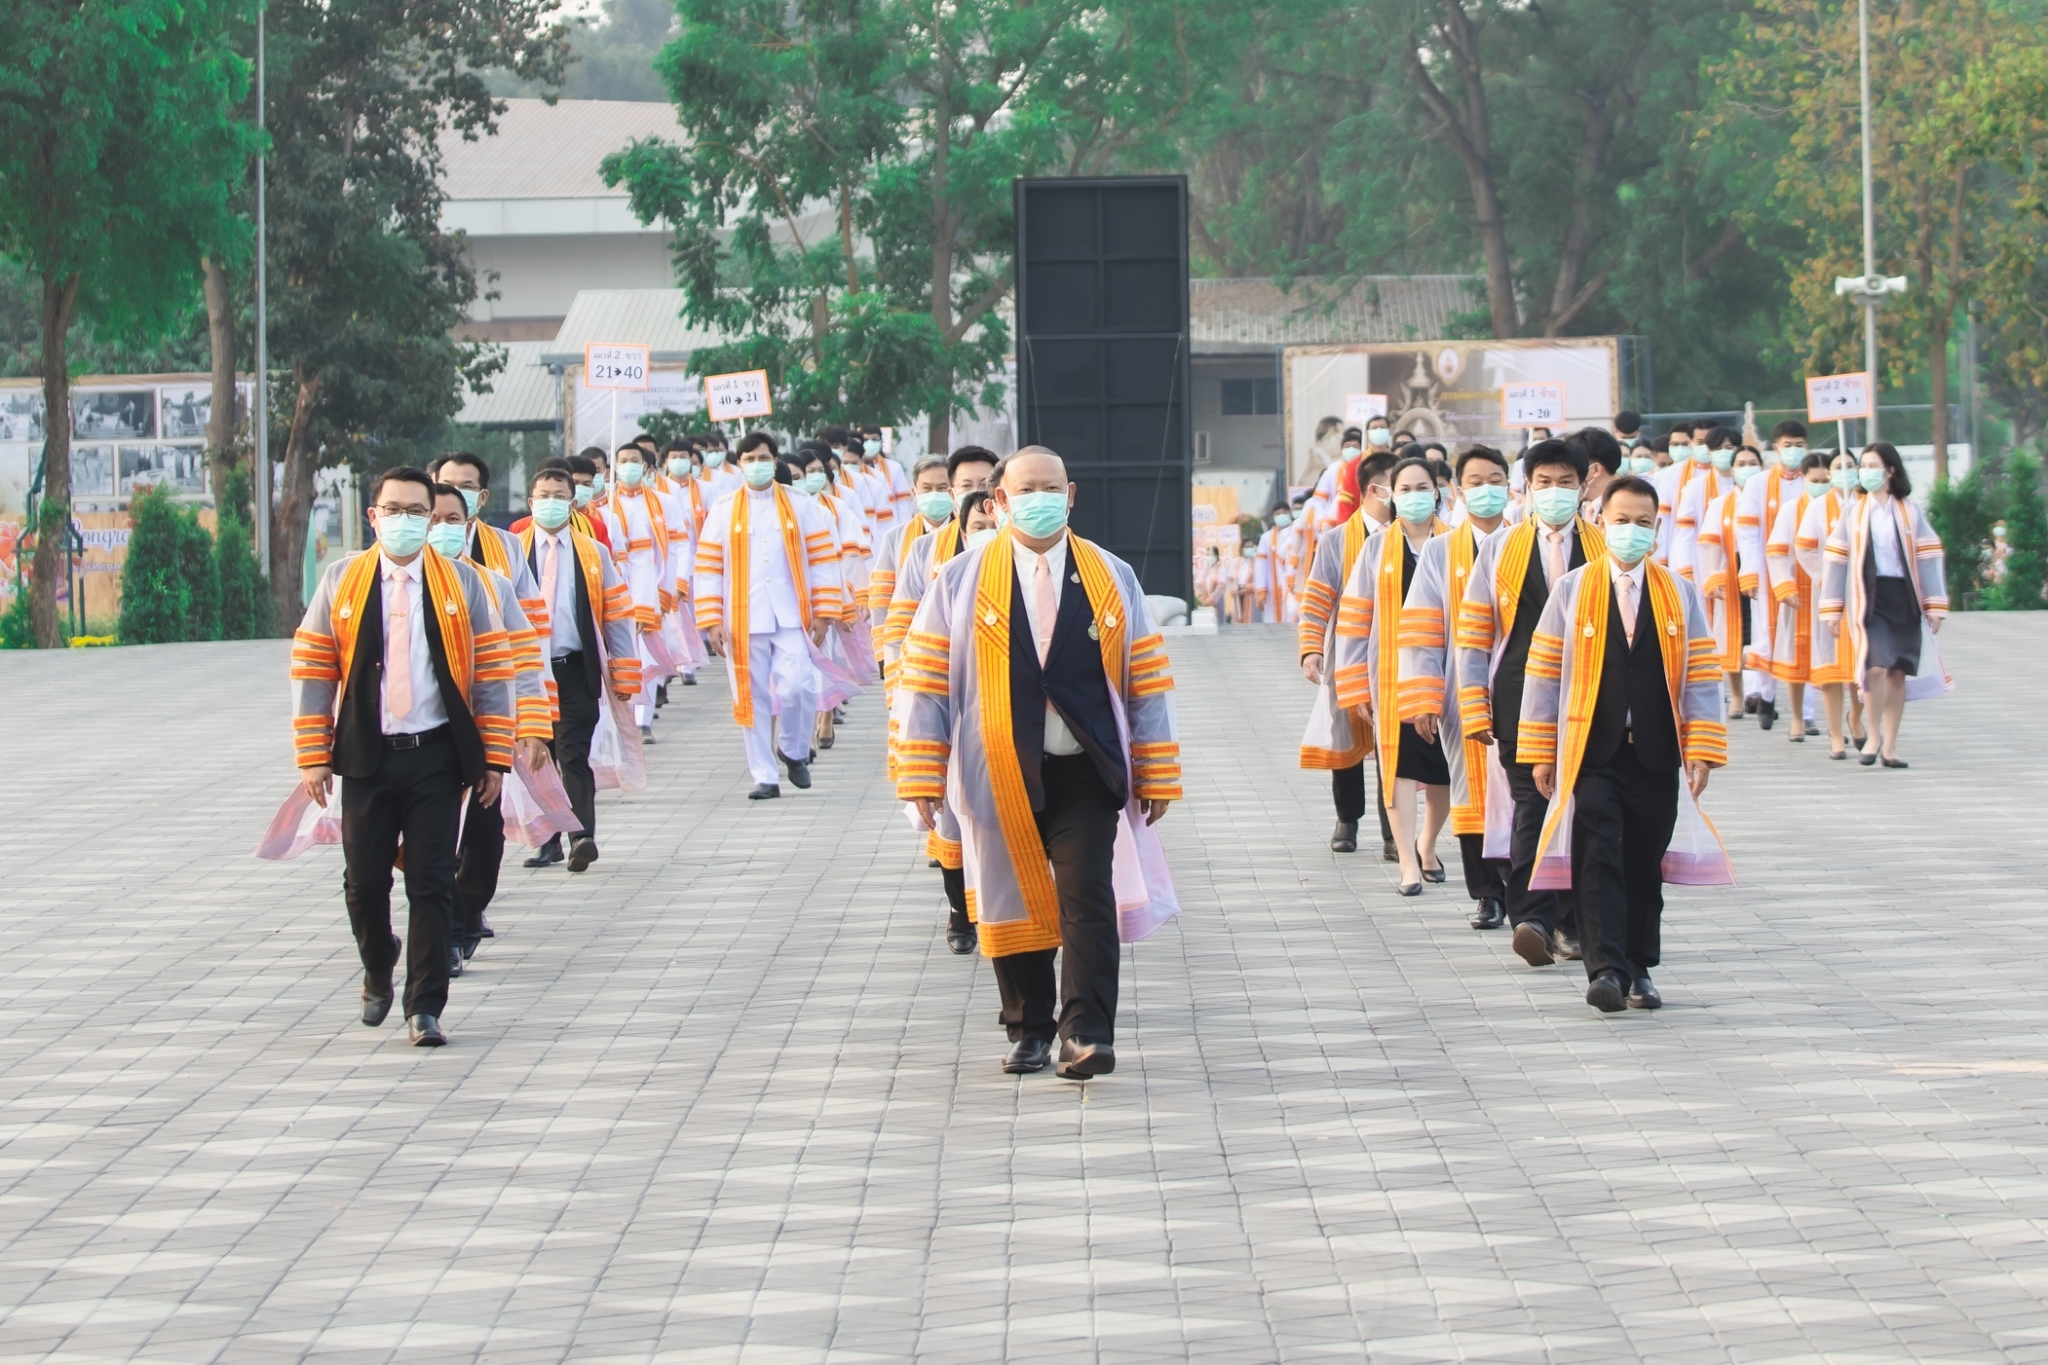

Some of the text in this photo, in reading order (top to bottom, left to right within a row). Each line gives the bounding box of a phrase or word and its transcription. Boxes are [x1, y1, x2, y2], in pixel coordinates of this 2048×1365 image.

[614, 350, 621, 360] 2
[595, 365, 612, 379] 21
[624, 366, 643, 380] 40
[1833, 380, 1840, 390] 2
[746, 391, 758, 402] 21
[1530, 388, 1535, 398] 1
[719, 394, 732, 405] 40
[1518, 408, 1522, 419] 1
[1537, 408, 1550, 419] 20
